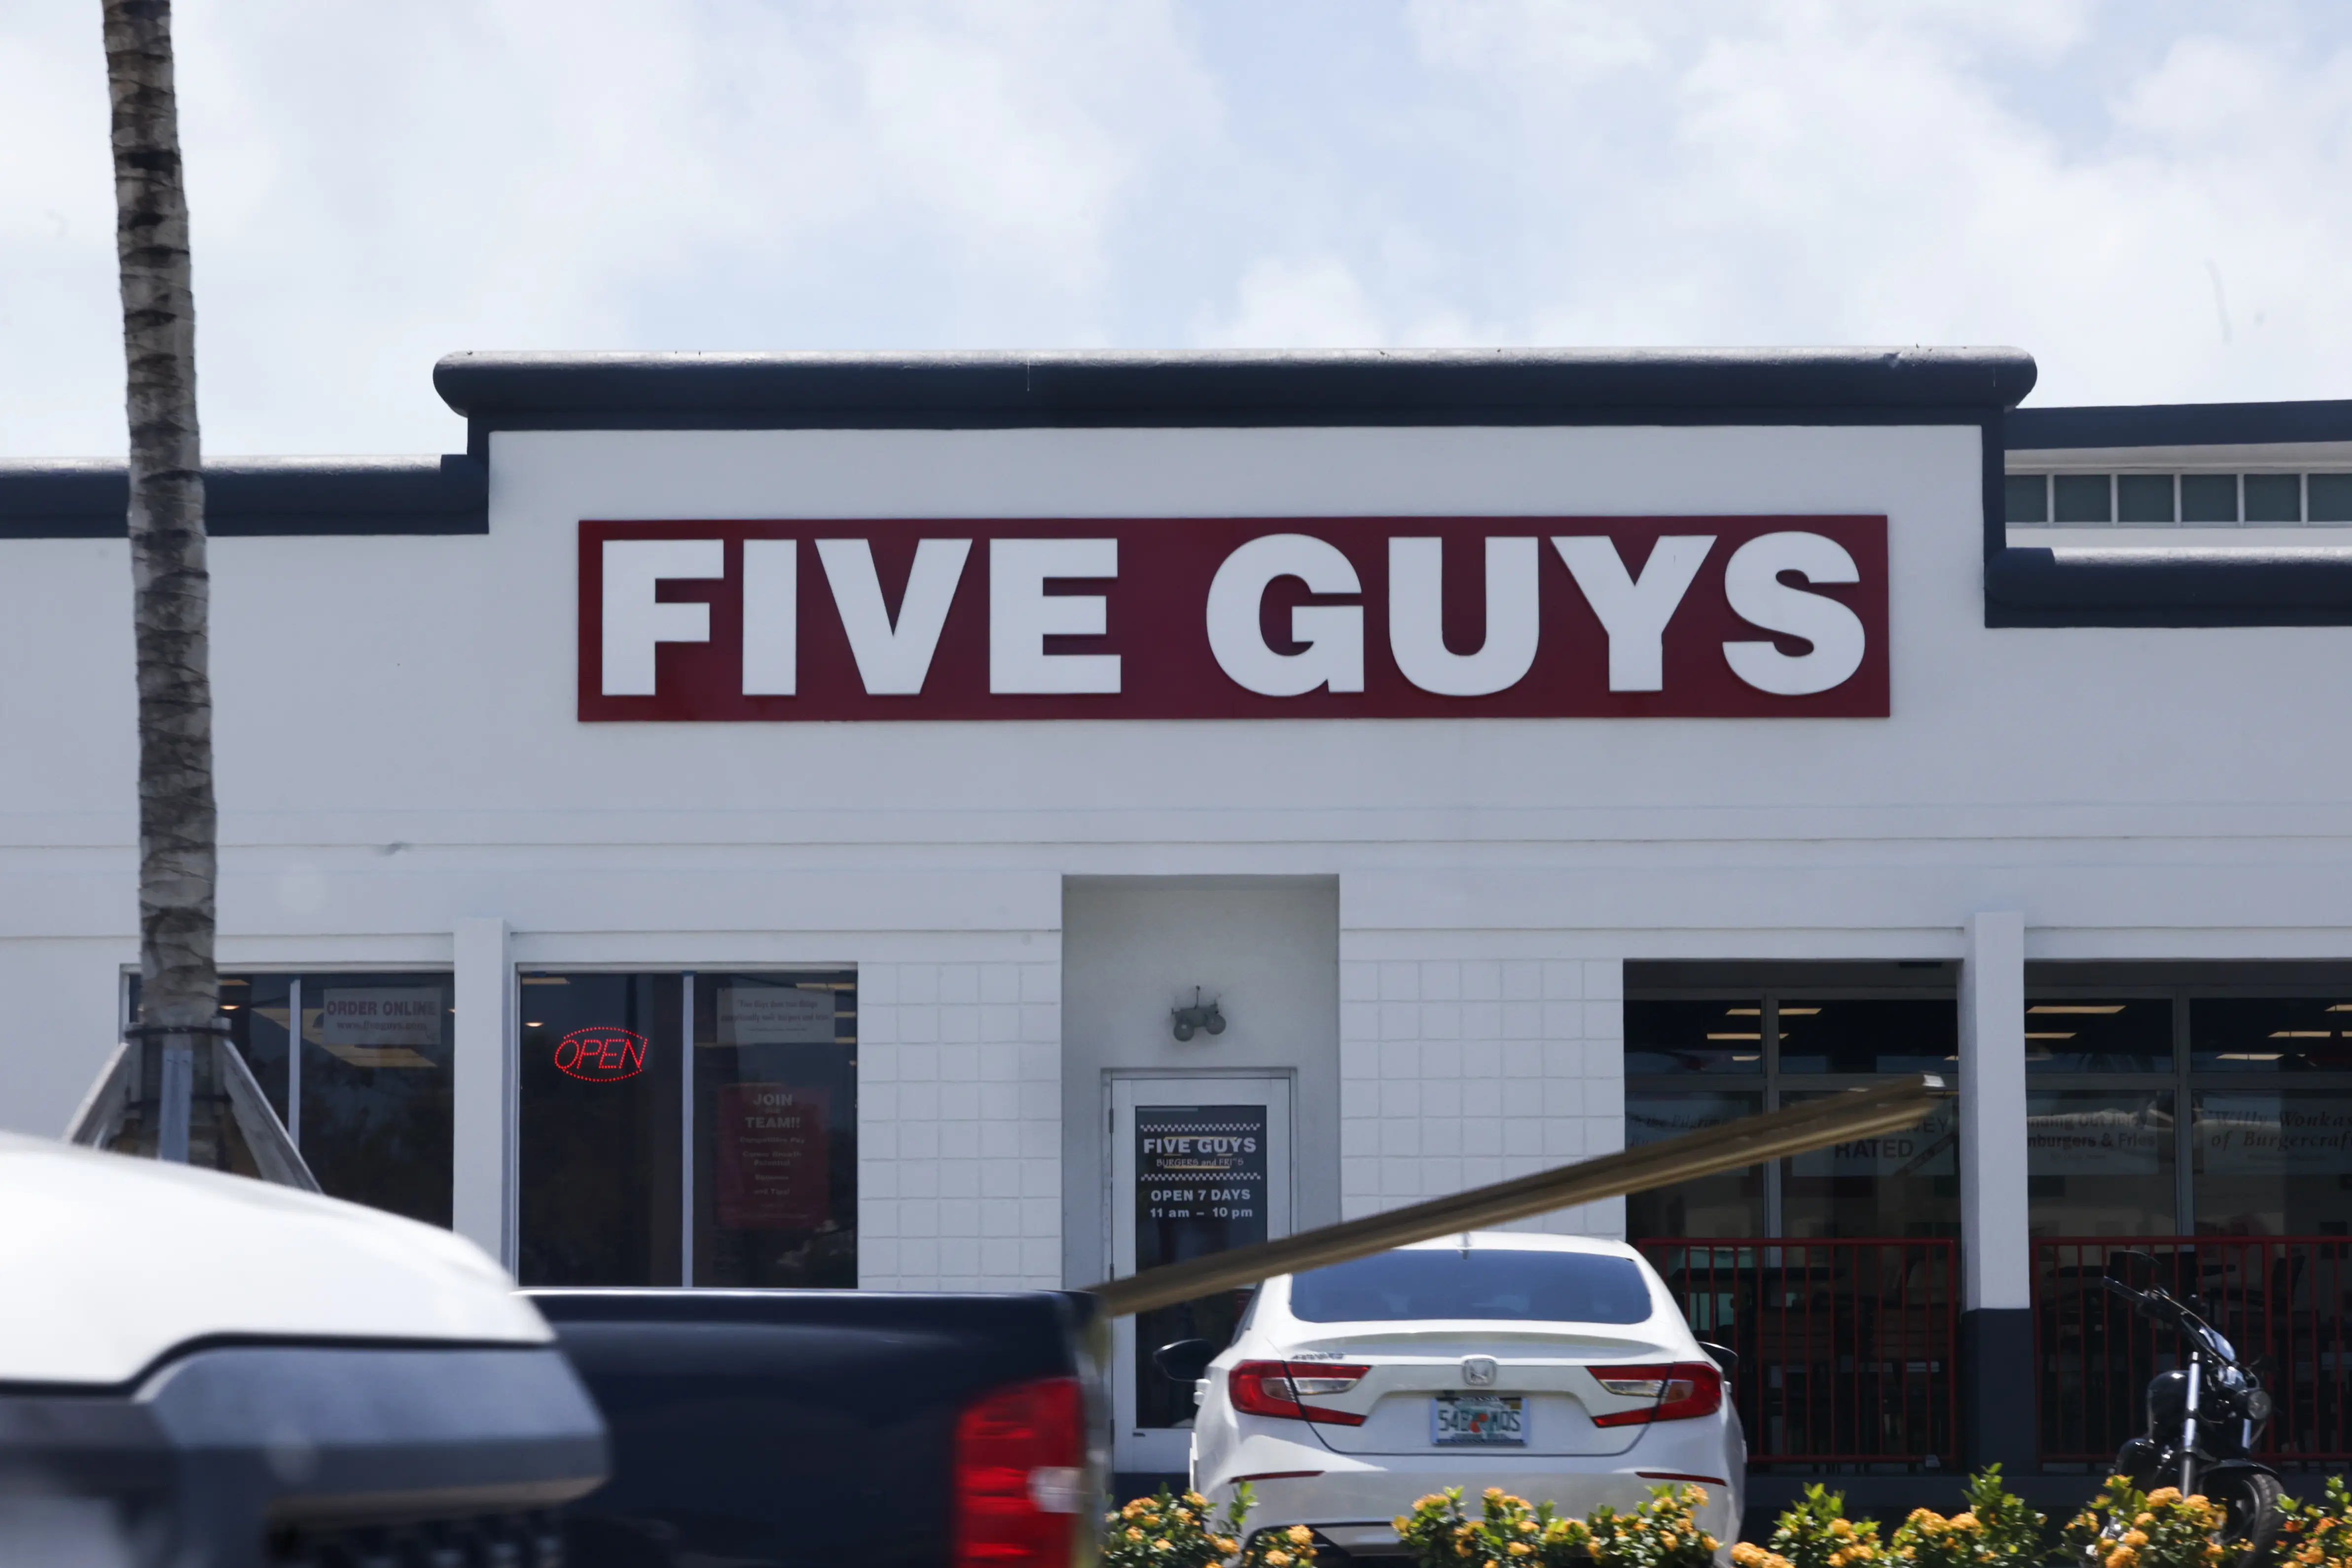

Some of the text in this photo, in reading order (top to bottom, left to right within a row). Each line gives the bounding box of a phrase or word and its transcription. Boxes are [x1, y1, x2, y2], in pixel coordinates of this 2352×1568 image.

[601, 532, 1867, 697] FIVE GUYS
[326, 1001, 437, 1016] ORDER ONLINE
[554, 1038, 648, 1069] OPEN
[753, 1094, 793, 1105] JOIN
[745, 1117, 800, 1129] TEAM!!
[1144, 1137, 1256, 1153] FIVE GUYS
[2118, 1132, 2156, 1147] Fries
[2211, 1130, 2352, 1151] of Burgercraf
[1835, 1138, 1914, 1158] RATED
[1157, 1159, 1198, 1167] BURGERS
[1151, 1189, 1251, 1201] OPEN 7 DAYS
[1150, 1208, 1163, 1217] 11
[1213, 1207, 1228, 1217] 10
[1232, 1209, 1253, 1219] pm
